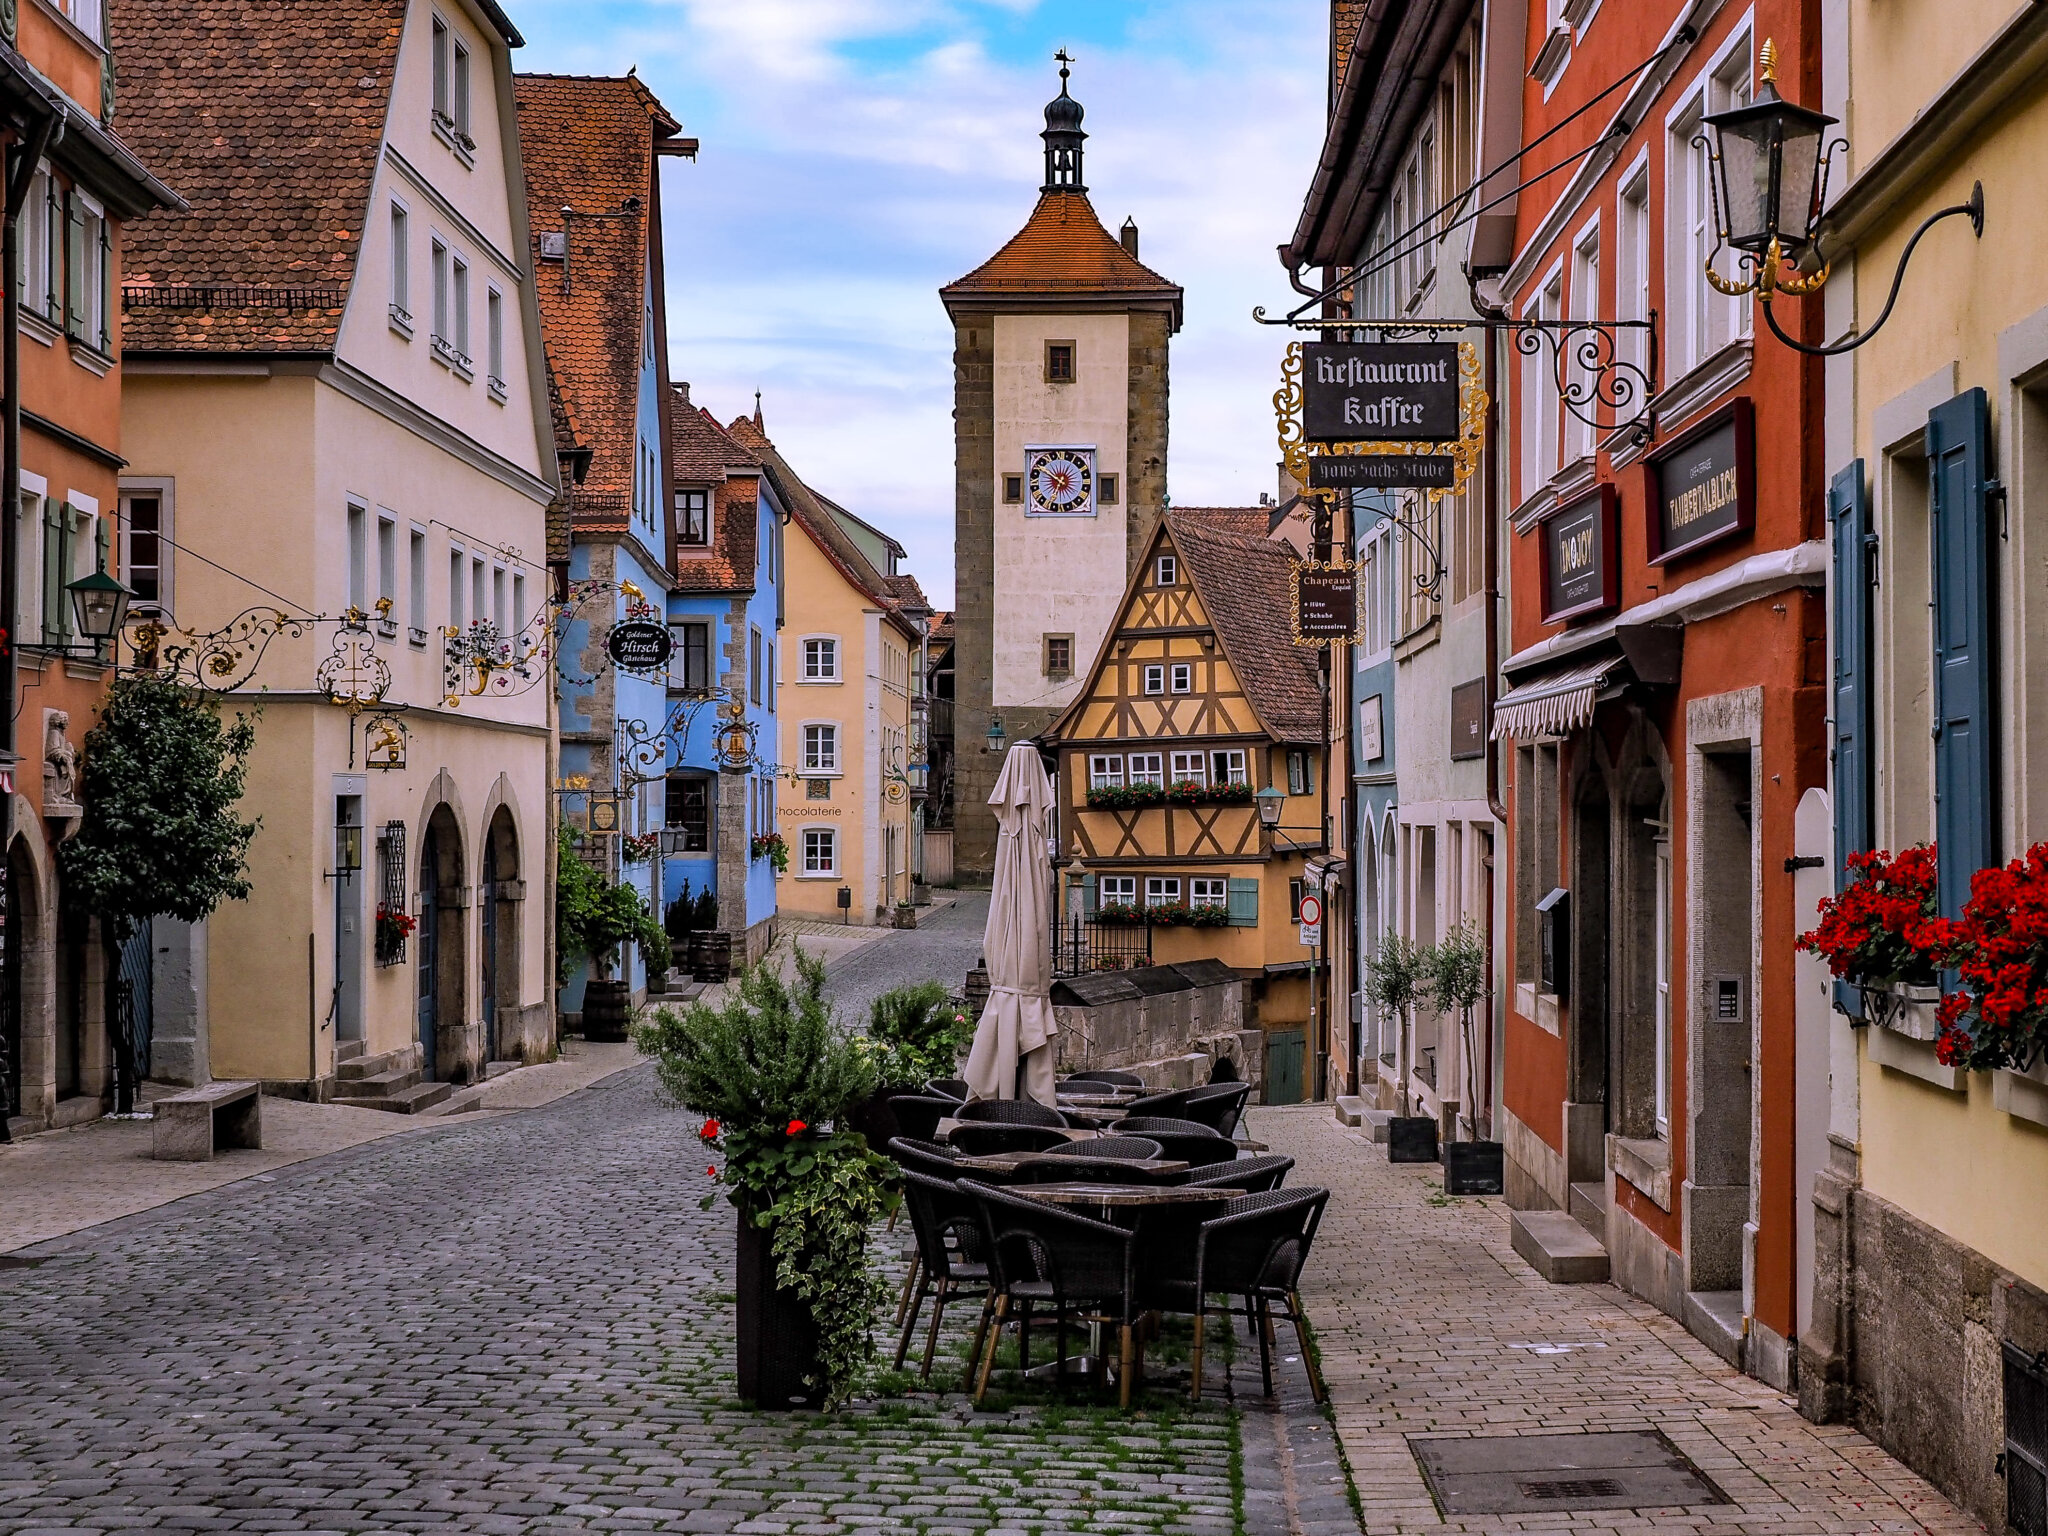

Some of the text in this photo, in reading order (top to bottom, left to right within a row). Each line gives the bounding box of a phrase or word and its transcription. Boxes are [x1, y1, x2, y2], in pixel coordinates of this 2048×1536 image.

[1316, 356, 1448, 388] Restaurant
[1343, 396, 1425, 427] Kaffee
[1320, 461, 1445, 479] Hans Sachs Stube
[1670, 466, 1737, 530] TAUBERTALBLICK
[1303, 576, 1351, 586] Chapeaux
[626, 630, 654, 639] Goldener
[620, 640, 660, 653] Hirsch
[622, 654, 656, 663] Gästehaus
